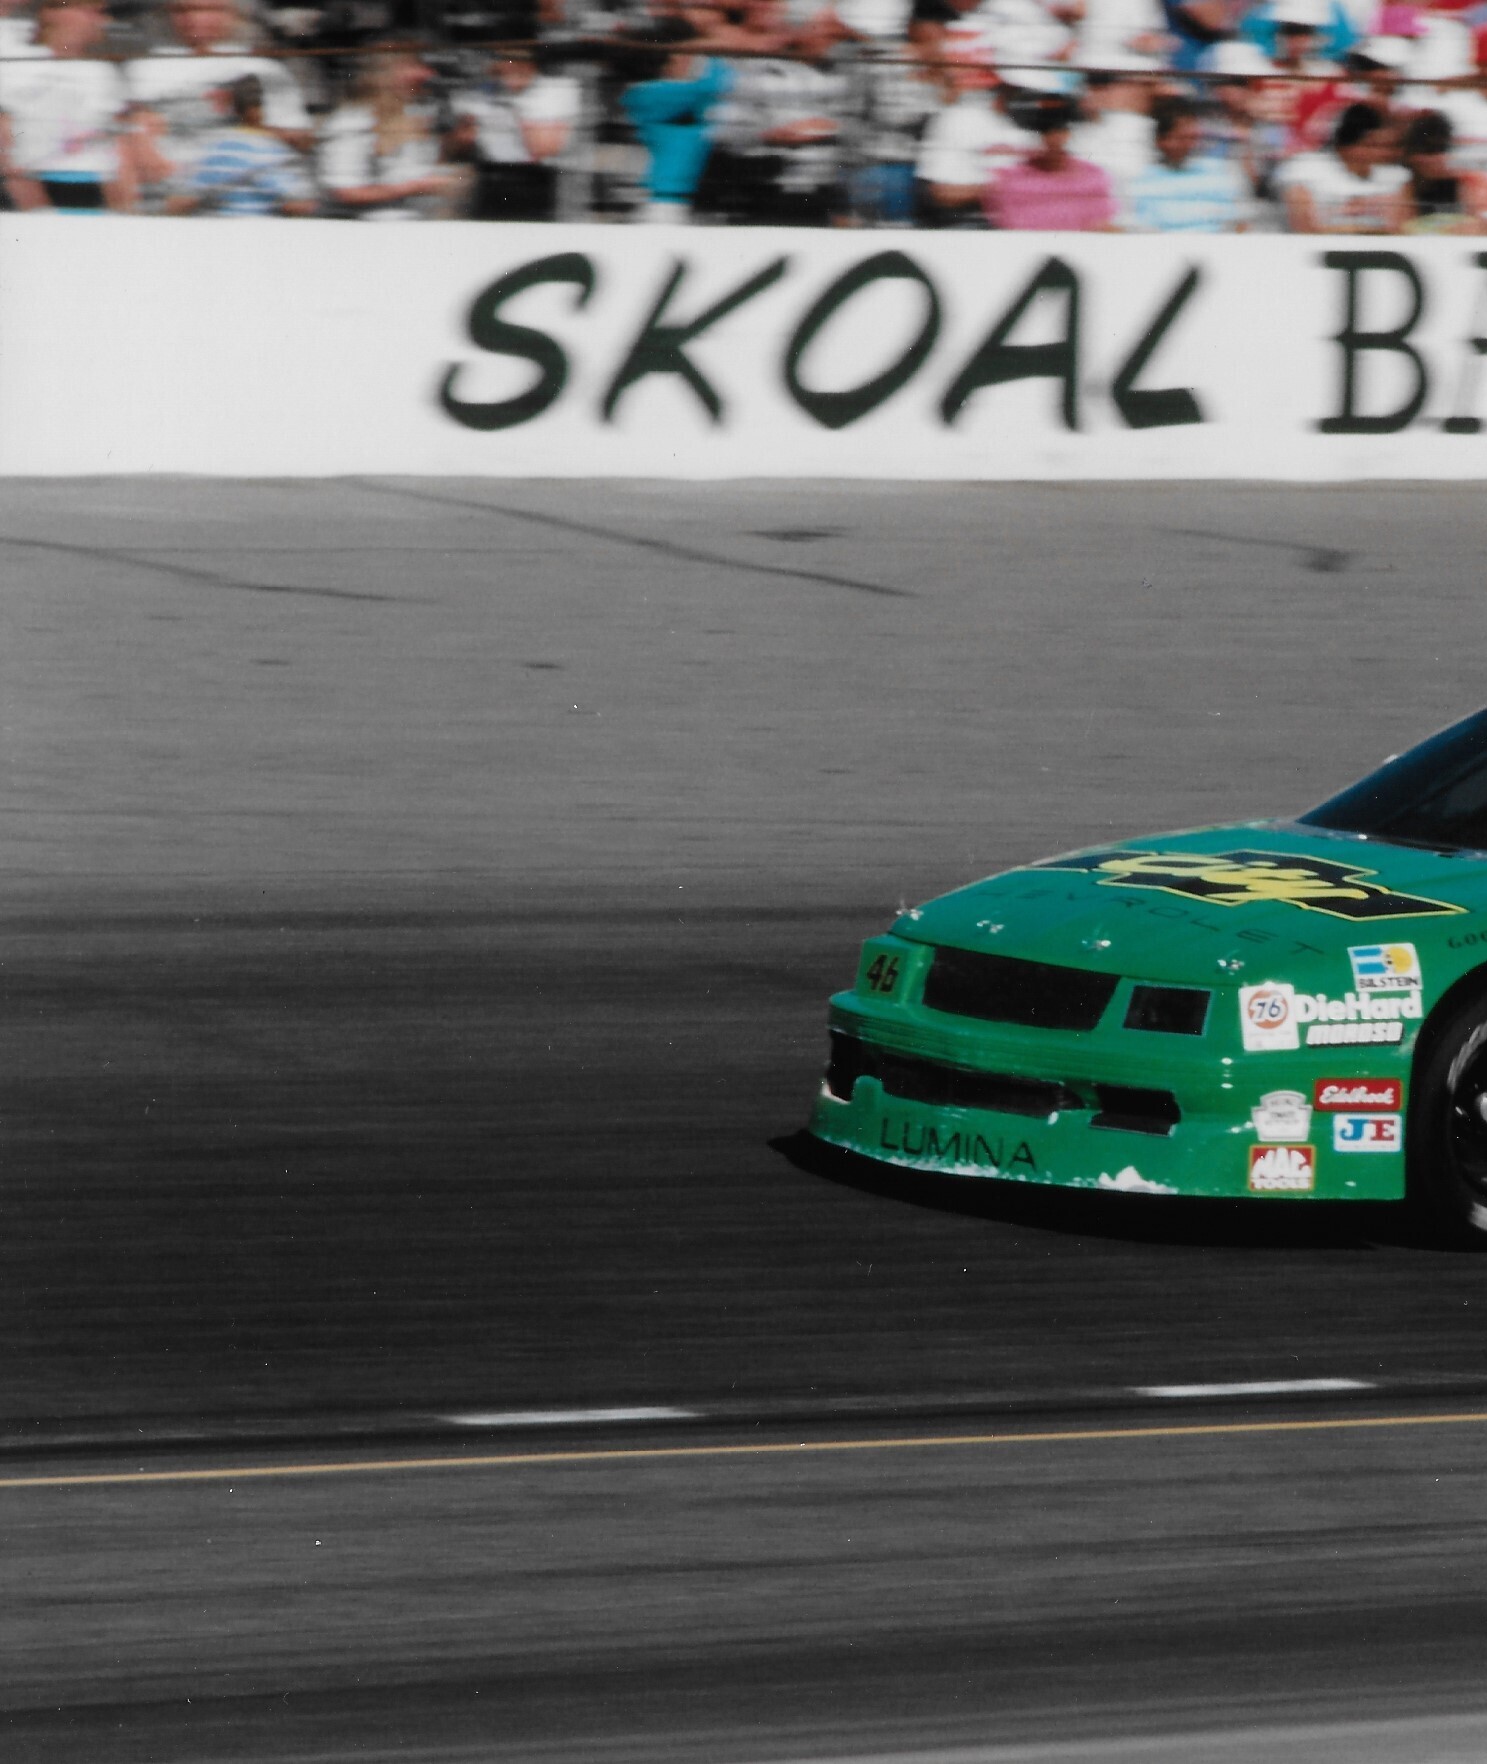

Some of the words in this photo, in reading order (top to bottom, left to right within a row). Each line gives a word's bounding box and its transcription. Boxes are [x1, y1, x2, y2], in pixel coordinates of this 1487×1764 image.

[440, 252, 1203, 430] SKOAL
[867, 953, 899, 993] 46
[1358, 976, 1420, 989] BILSTEIN
[1255, 999, 1282, 1019] 76
[1296, 990, 1423, 1023] DieHard
[880, 1117, 1038, 1173] LUMINA
[1339, 1118, 1395, 1142] JE
